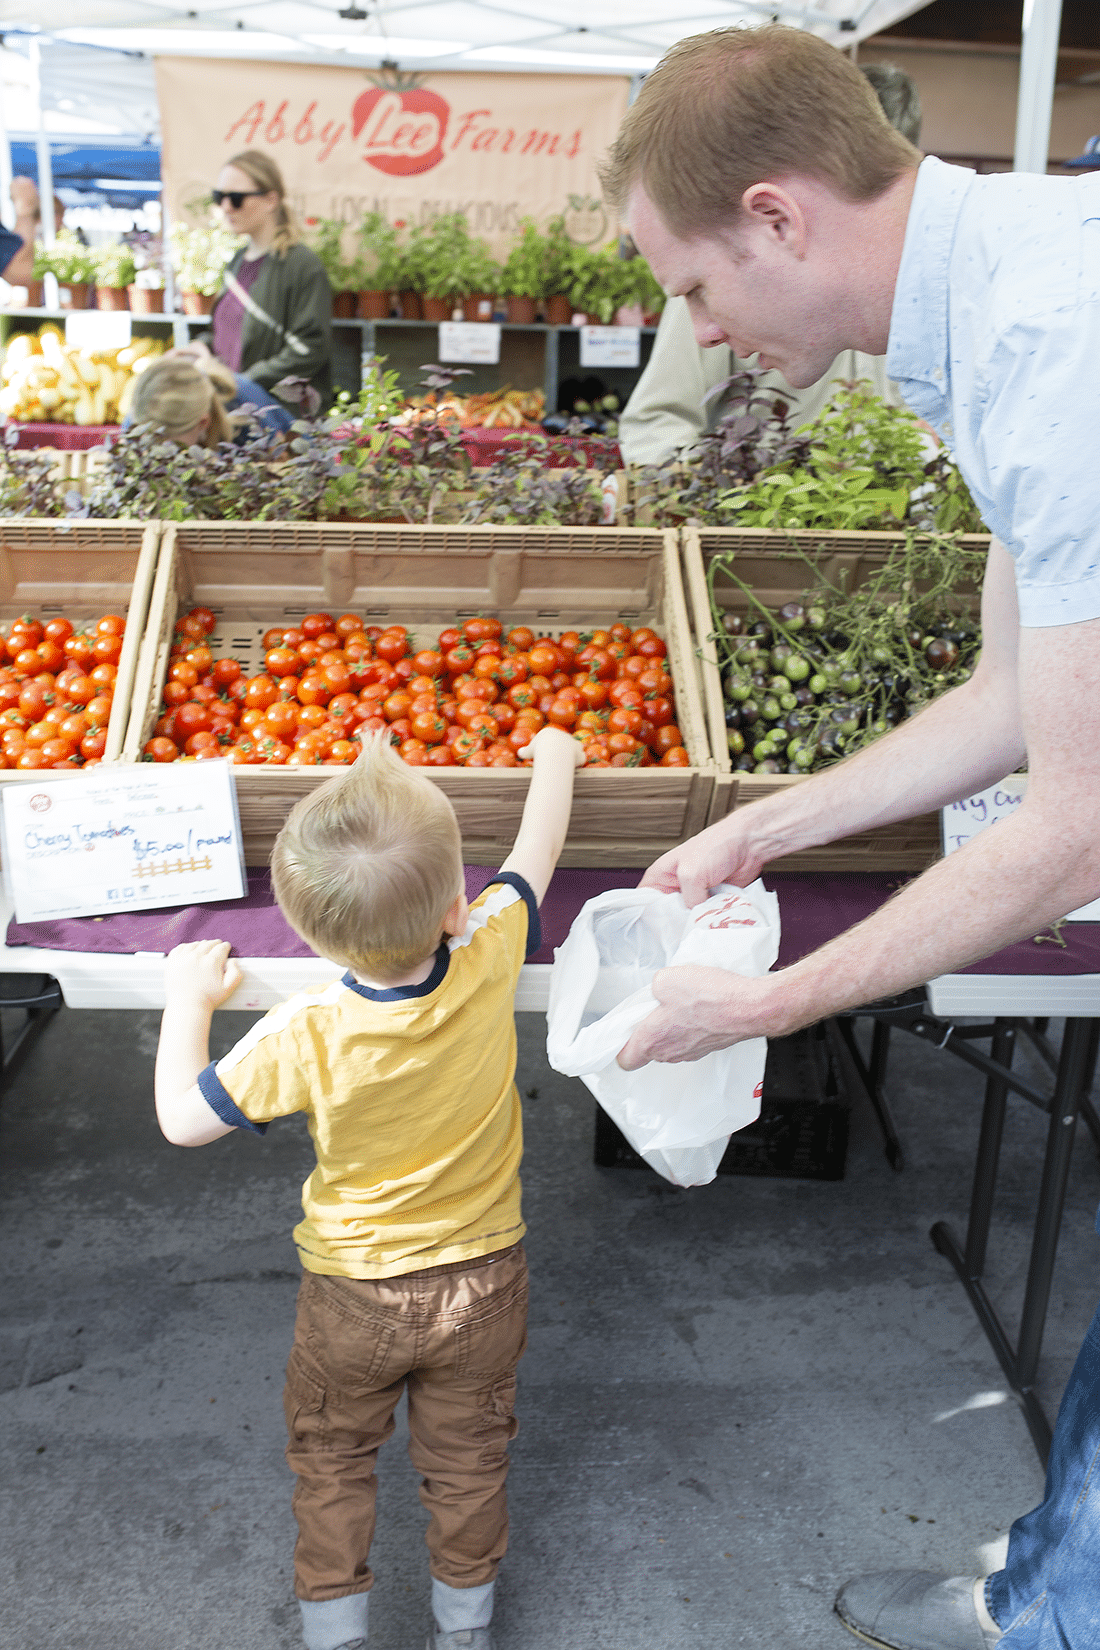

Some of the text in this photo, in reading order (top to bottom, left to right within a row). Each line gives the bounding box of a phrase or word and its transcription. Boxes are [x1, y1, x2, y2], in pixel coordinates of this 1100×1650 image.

[224, 99, 583, 162] Abby Lee Farms
